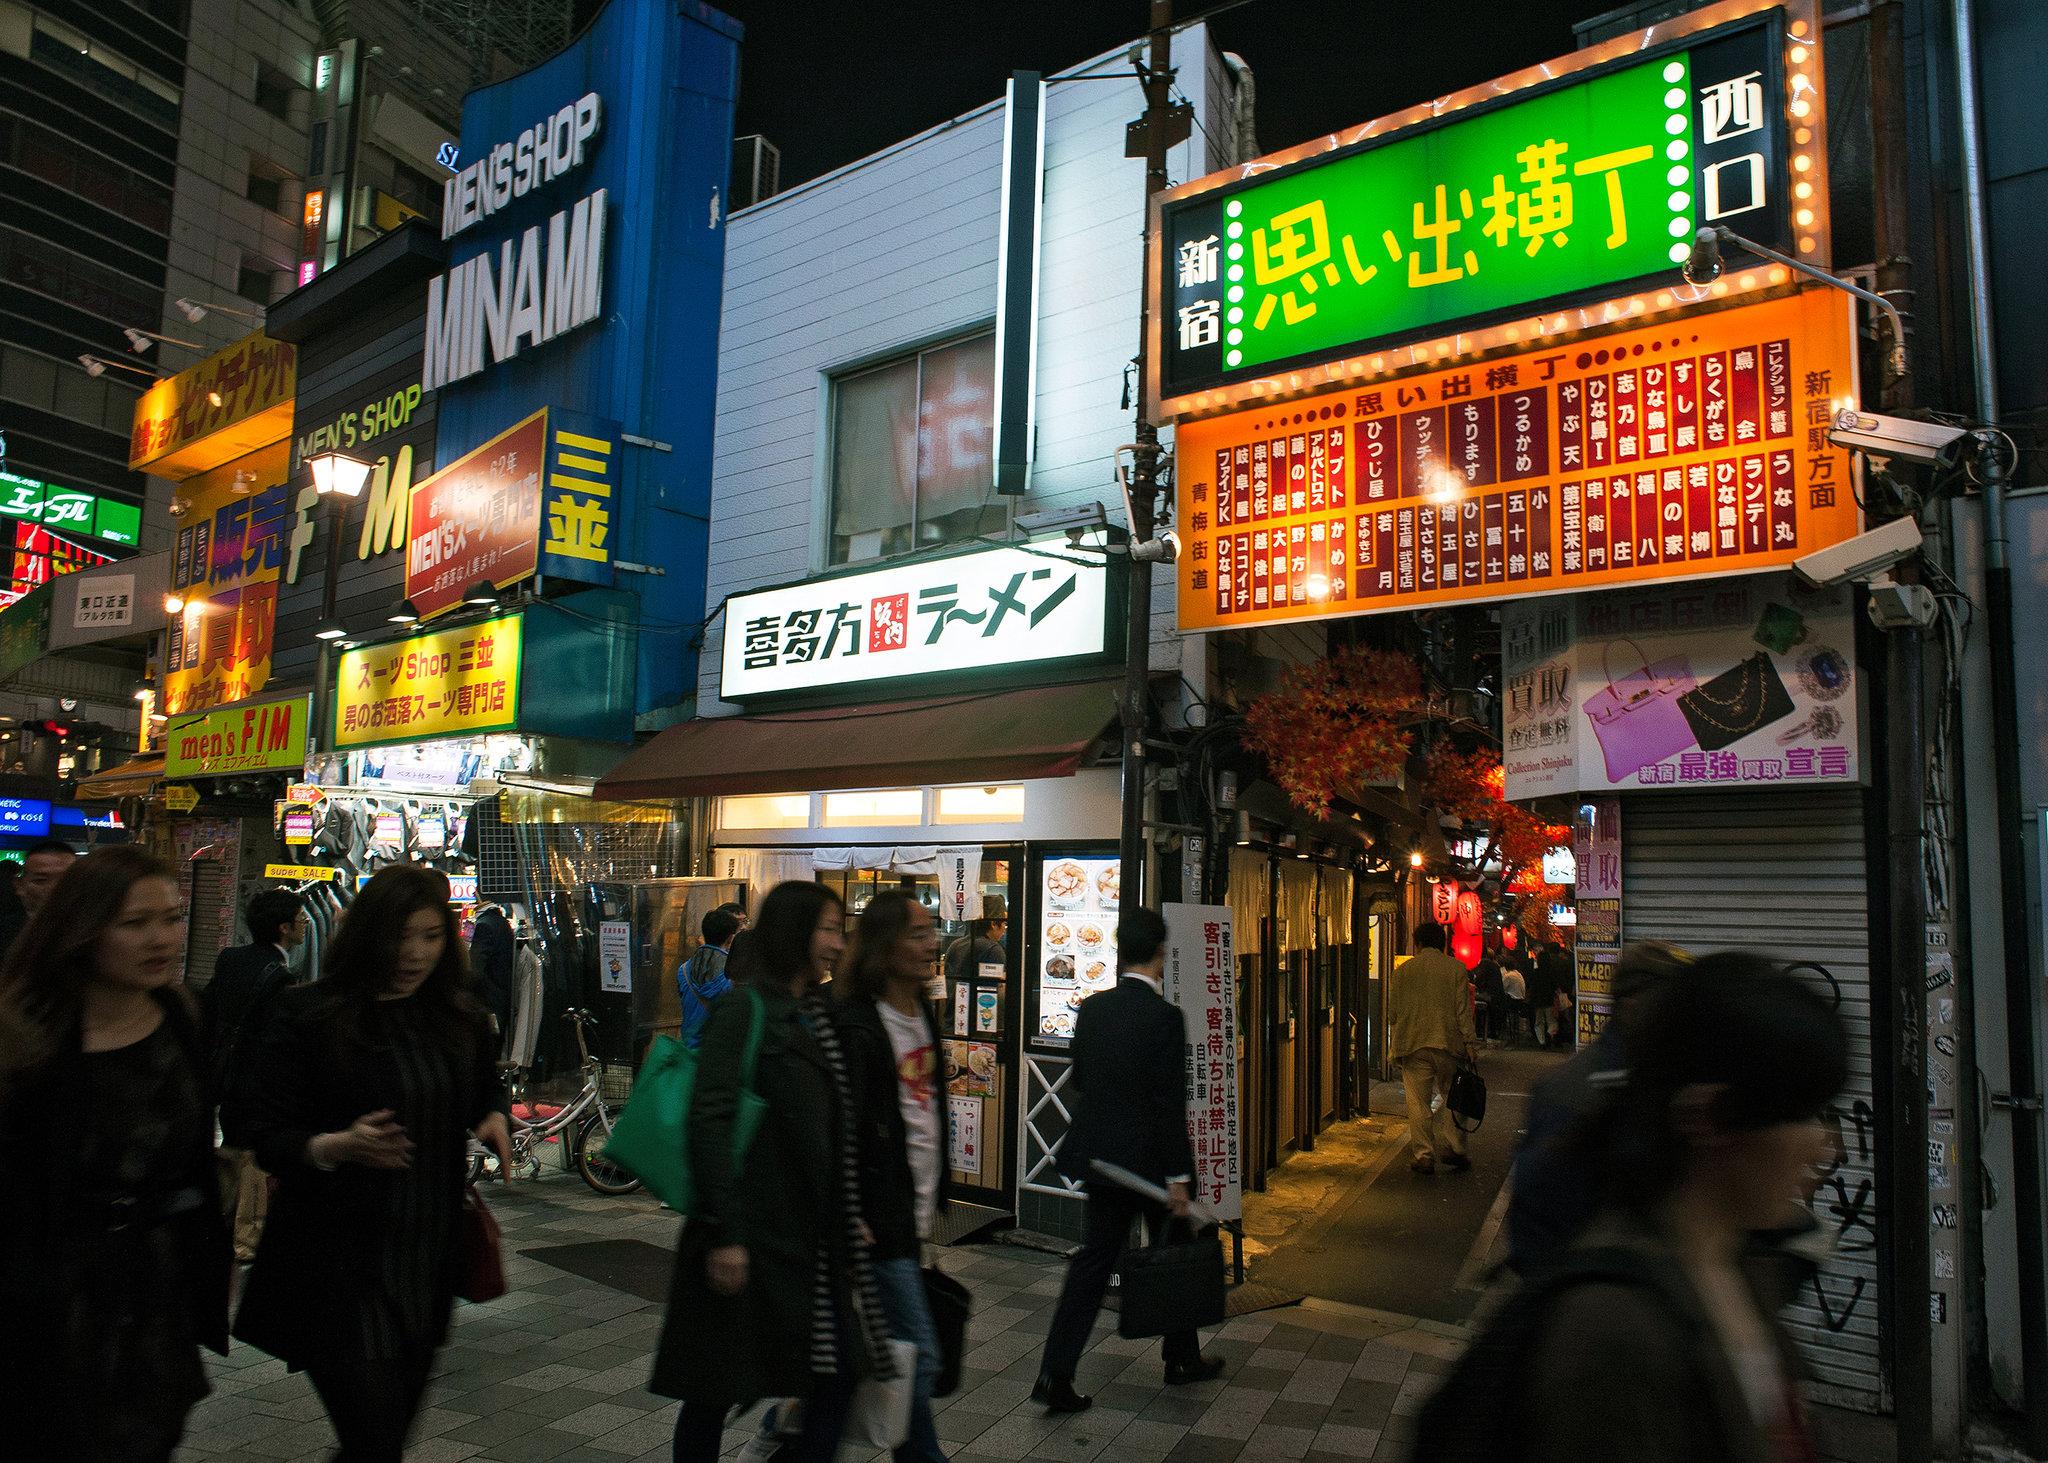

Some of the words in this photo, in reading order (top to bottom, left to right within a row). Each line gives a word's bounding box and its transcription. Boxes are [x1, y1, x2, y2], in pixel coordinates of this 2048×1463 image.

[441, 143, 513, 241] MEN'S
[512, 92, 601, 198] SHOP
[1700, 70, 1768, 222] 西口
[1252, 138, 1655, 332] 思い出横丁
[422, 187, 608, 393] MINAMI
[1177, 233, 1220, 351] 新宿
[1354, 354, 1567, 418] 思い出横丁
[1563, 386, 1581, 466] やぶ天
[1618, 374, 1638, 458] 志乃笛
[1675, 363, 1697, 449] すし辰
[1706, 358, 1727, 442] らくがき
[297, 411, 358, 470] MEN'S
[360, 383, 423, 443] SHOP
[1368, 422, 1385, 499] ひつじ屋
[1463, 405, 1481, 481] もります
[1515, 397, 1533, 473] つるかめ
[1804, 369, 1837, 511] 新宿駅方面
[544, 430, 613, 564] 三並
[1236, 449, 1250, 519] 岐阜屋
[1311, 434, 1326, 507] アルバトロス
[1330, 431, 1345, 504] カブト
[1773, 455, 1795, 543] うな丸
[209, 483, 291, 588] 販売
[286, 444, 414, 586] FM
[1191, 482, 1208, 591] 青梅街道
[1378, 514, 1394, 590] 若月
[1421, 509, 1436, 584] ささもと
[1441, 503, 1458, 582] 埼玉屋
[1464, 502, 1479, 579] ひさご
[1509, 495, 1527, 575] 五十鈴
[1532, 491, 1551, 572] 小松
[1587, 482, 1606, 567] 串衛門
[1613, 479, 1633, 562] 丸庄
[1637, 474, 1659, 560] 福八
[1664, 471, 1685, 556] 辰の家
[1237, 538, 1250, 607] ココイチ
[1255, 533, 1269, 605] 越後屋
[1273, 530, 1288, 603] 大黒屋
[1329, 522, 1346, 595] かめや
[457, 634, 495, 674] 三並
[744, 602, 862, 671] 喜多方
[179, 720, 235, 760] men's
[240, 704, 292, 754] FIM
[343, 679, 507, 733] 男のお洒落スーツ専門店
[1507, 659, 1573, 725] 買取
[302, 866, 327, 878] SALE
